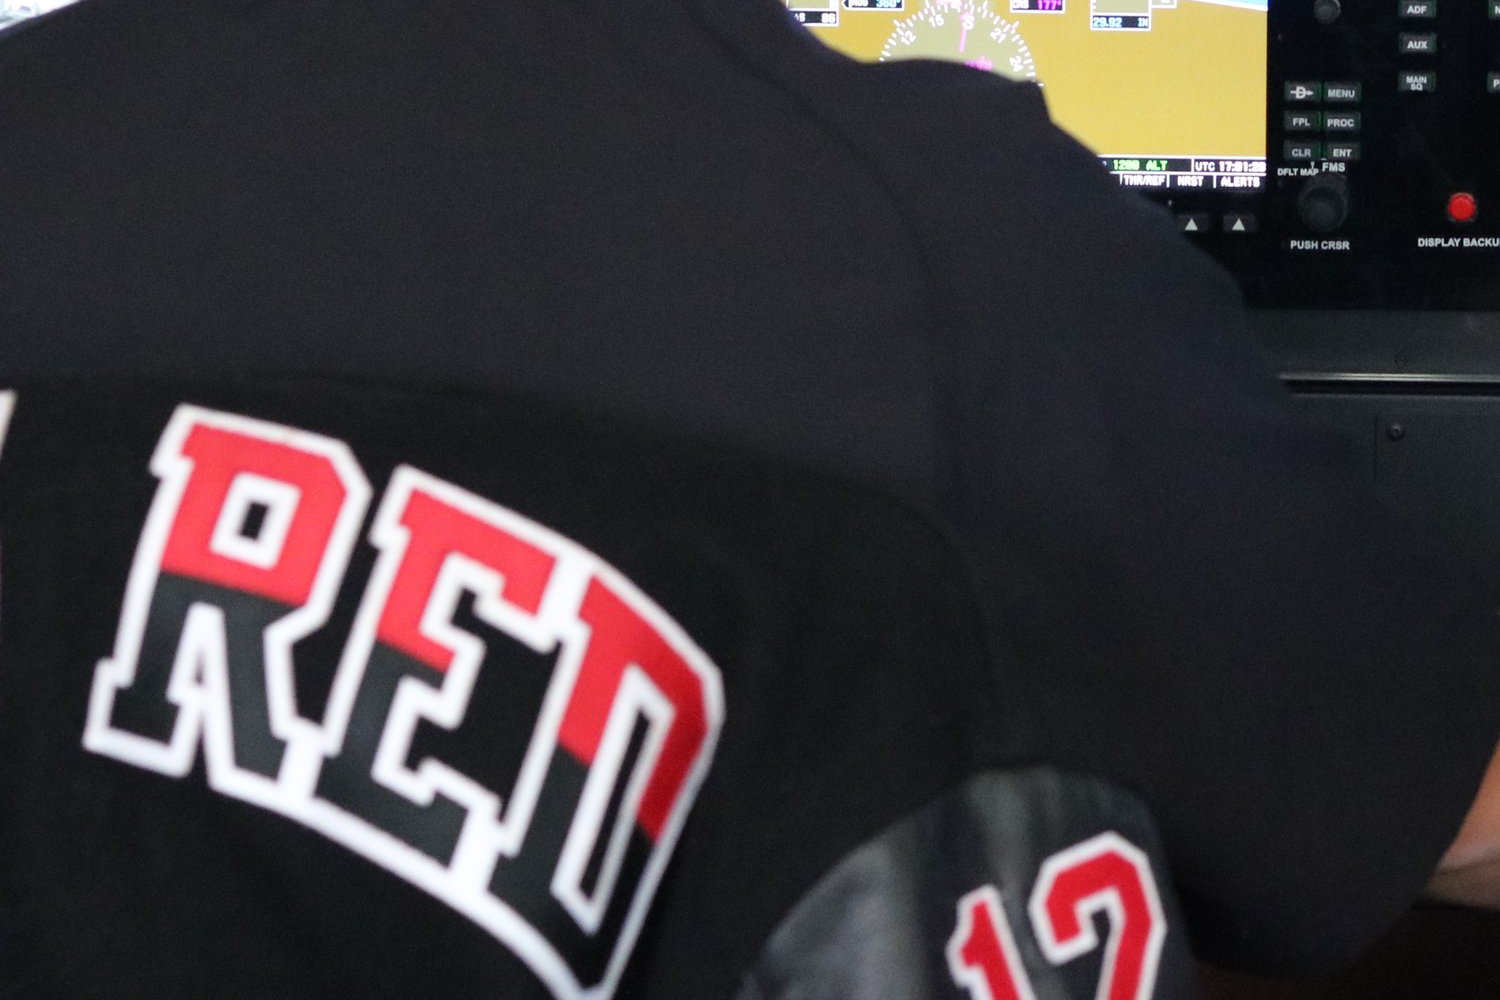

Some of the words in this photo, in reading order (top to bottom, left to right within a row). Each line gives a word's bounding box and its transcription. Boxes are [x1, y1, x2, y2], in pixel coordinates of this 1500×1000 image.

[1408, 5, 1427, 14] ADF
[1407, 41, 1428, 49] AUX
[1406, 76, 1427, 84] MAIN
[1328, 88, 1355, 98] MENU
[1293, 118, 1310, 126] FPL
[1327, 118, 1354, 128] PROC
[1292, 148, 1311, 157] CLR
[1333, 148, 1352, 157] ENT
[1196, 162, 1215, 172] UTC
[1277, 168, 1299, 176] DFLT
[1300, 168, 1319, 176] MAP
[1322, 162, 1345, 172] FMS
[1221, 176, 1260, 188] ALERTS
[1290, 240, 1318, 249] PUSH
[1321, 240, 1350, 250] CRSR
[1418, 238, 1461, 248] DISPLAY
[82, 402, 726, 1000] RED
